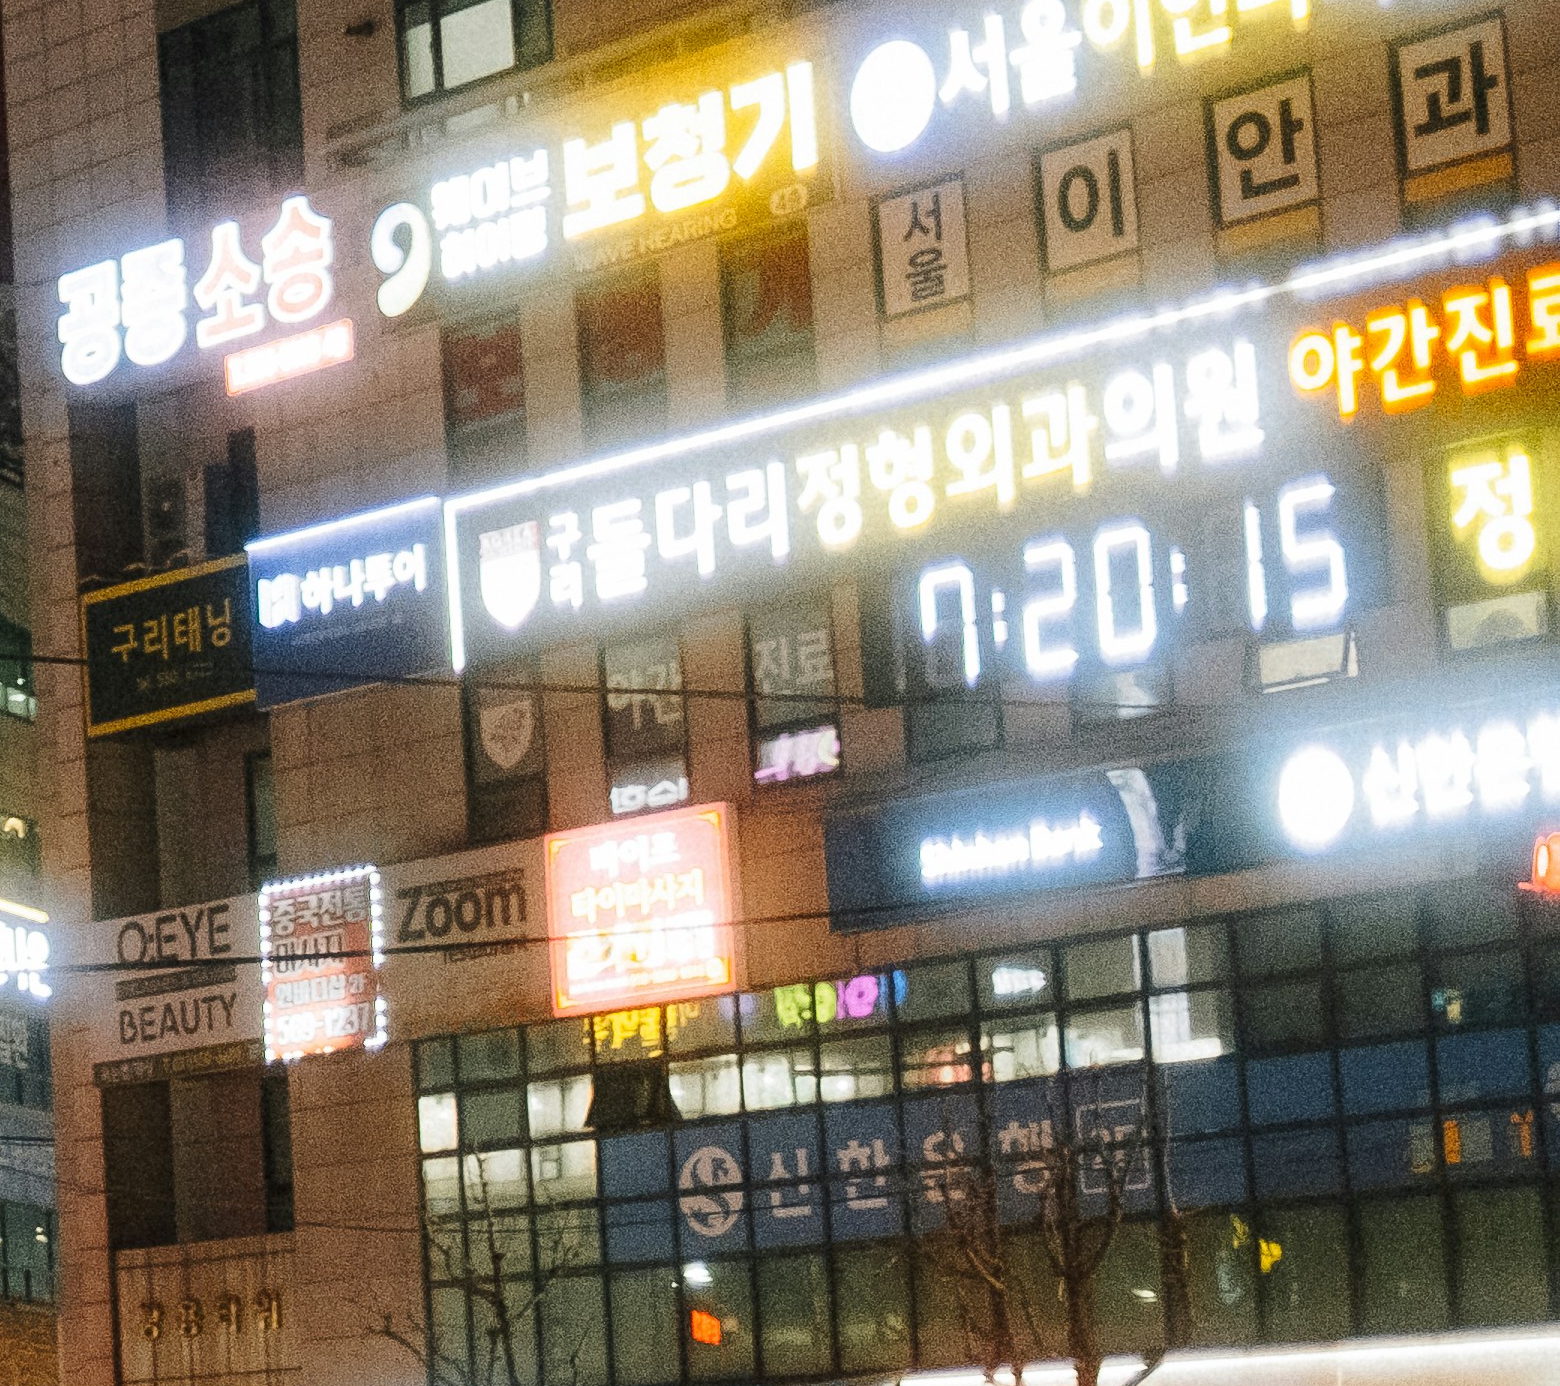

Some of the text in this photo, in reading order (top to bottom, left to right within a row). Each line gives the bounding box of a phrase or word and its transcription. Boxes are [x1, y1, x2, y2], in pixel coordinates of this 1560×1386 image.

[562, 61, 820, 243] 보청기
[1059, 150, 1124, 237] 이
[1226, 90, 1306, 200] 안
[1412, 41, 1498, 140] 과
[194, 196, 332, 349] 소송
[1452, 451, 1536, 573] 정
[301, 544, 427, 613] 하나투어
[111, 598, 232, 662] 구리태닝
[273, 886, 366, 937] 중국전통
[398, 881, 527, 943] Zoom
[119, 991, 237, 1046] BEAUTY
